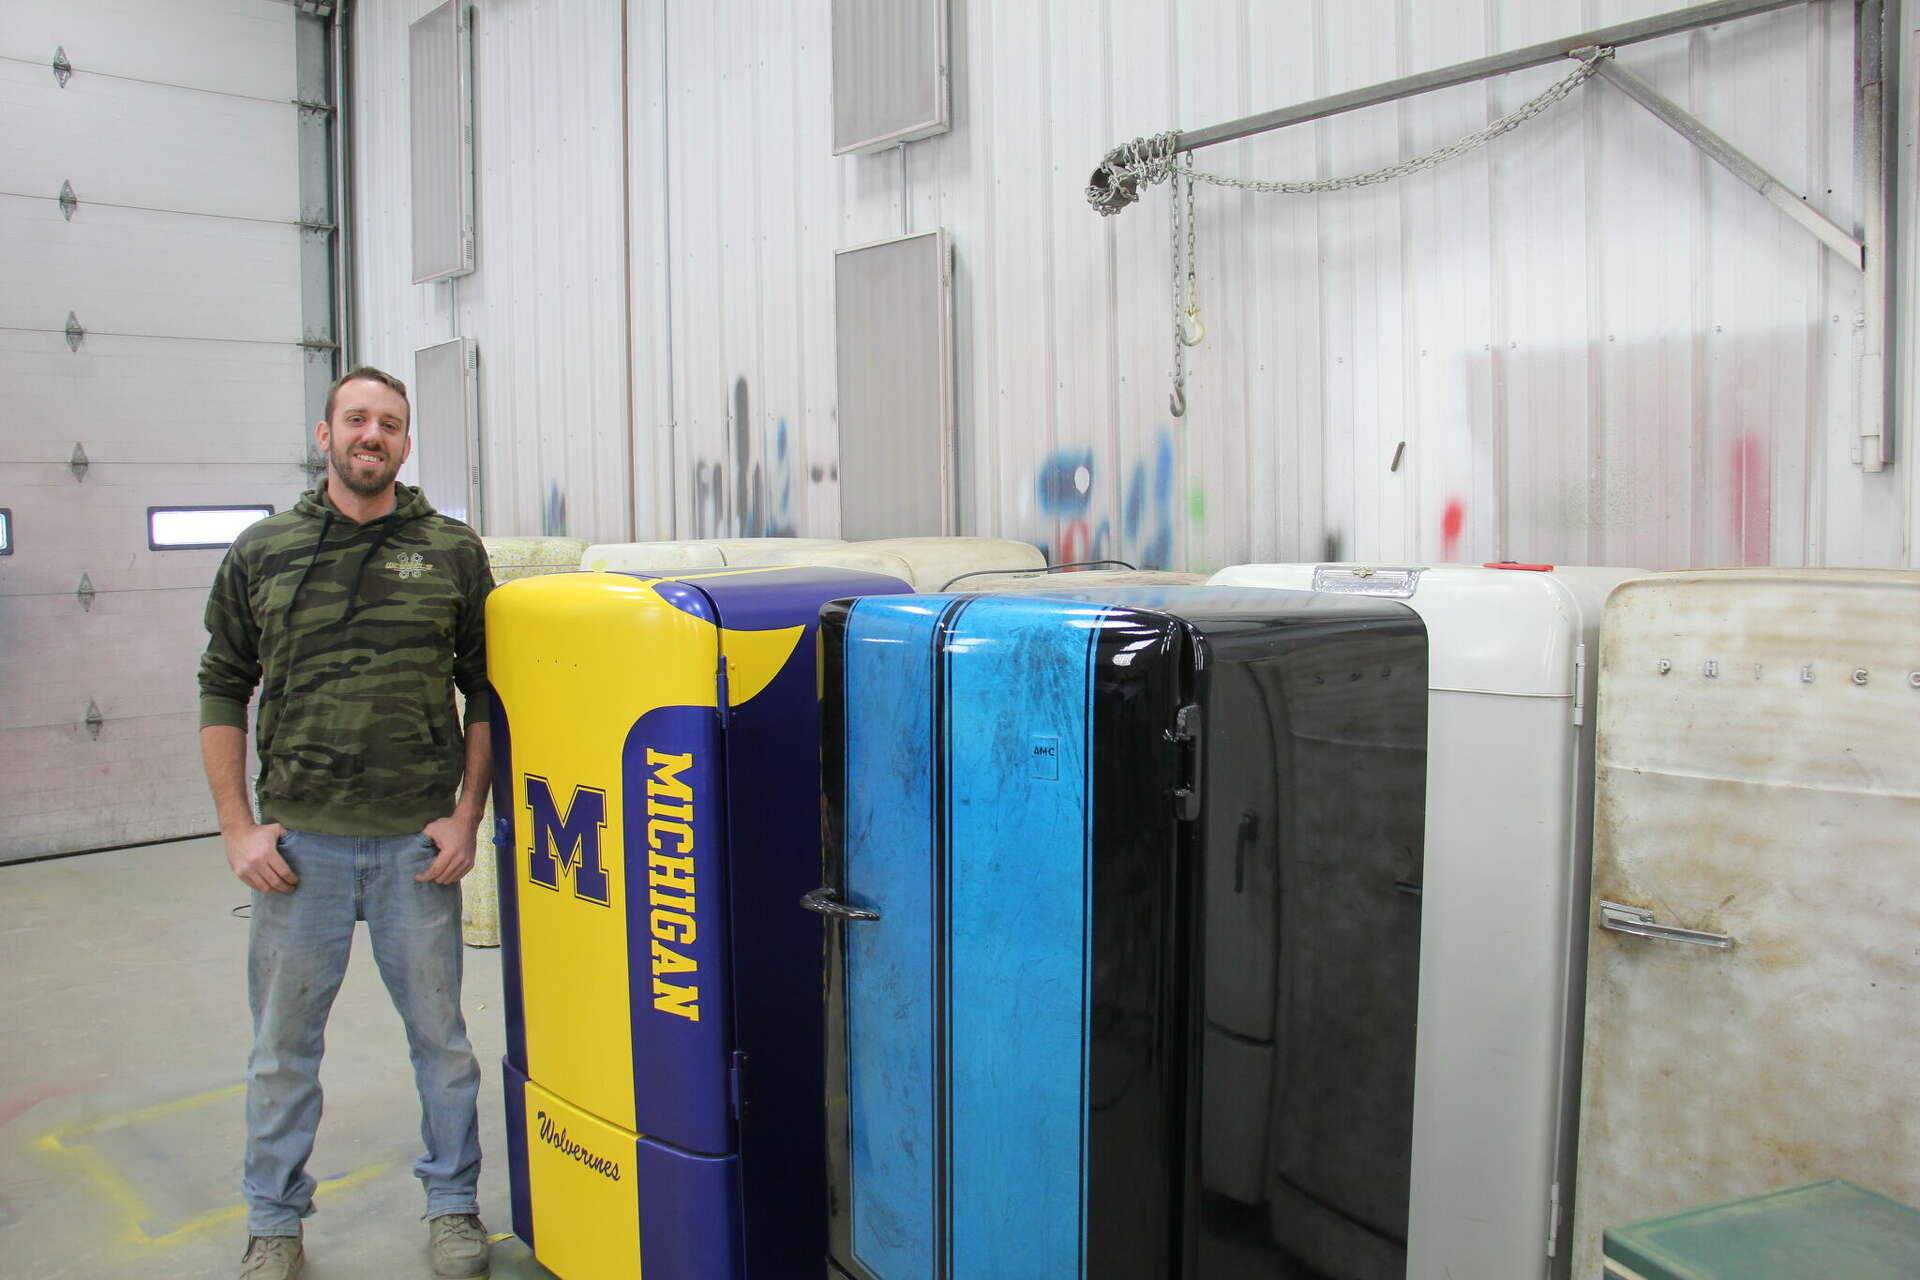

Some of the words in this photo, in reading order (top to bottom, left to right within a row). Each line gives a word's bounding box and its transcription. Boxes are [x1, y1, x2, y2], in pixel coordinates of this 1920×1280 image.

[1033, 746, 1056, 757] AMC
[524, 773, 610, 907] M
[646, 748, 700, 1022] MICHIGAN
[537, 1110, 621, 1181] Wolverines
